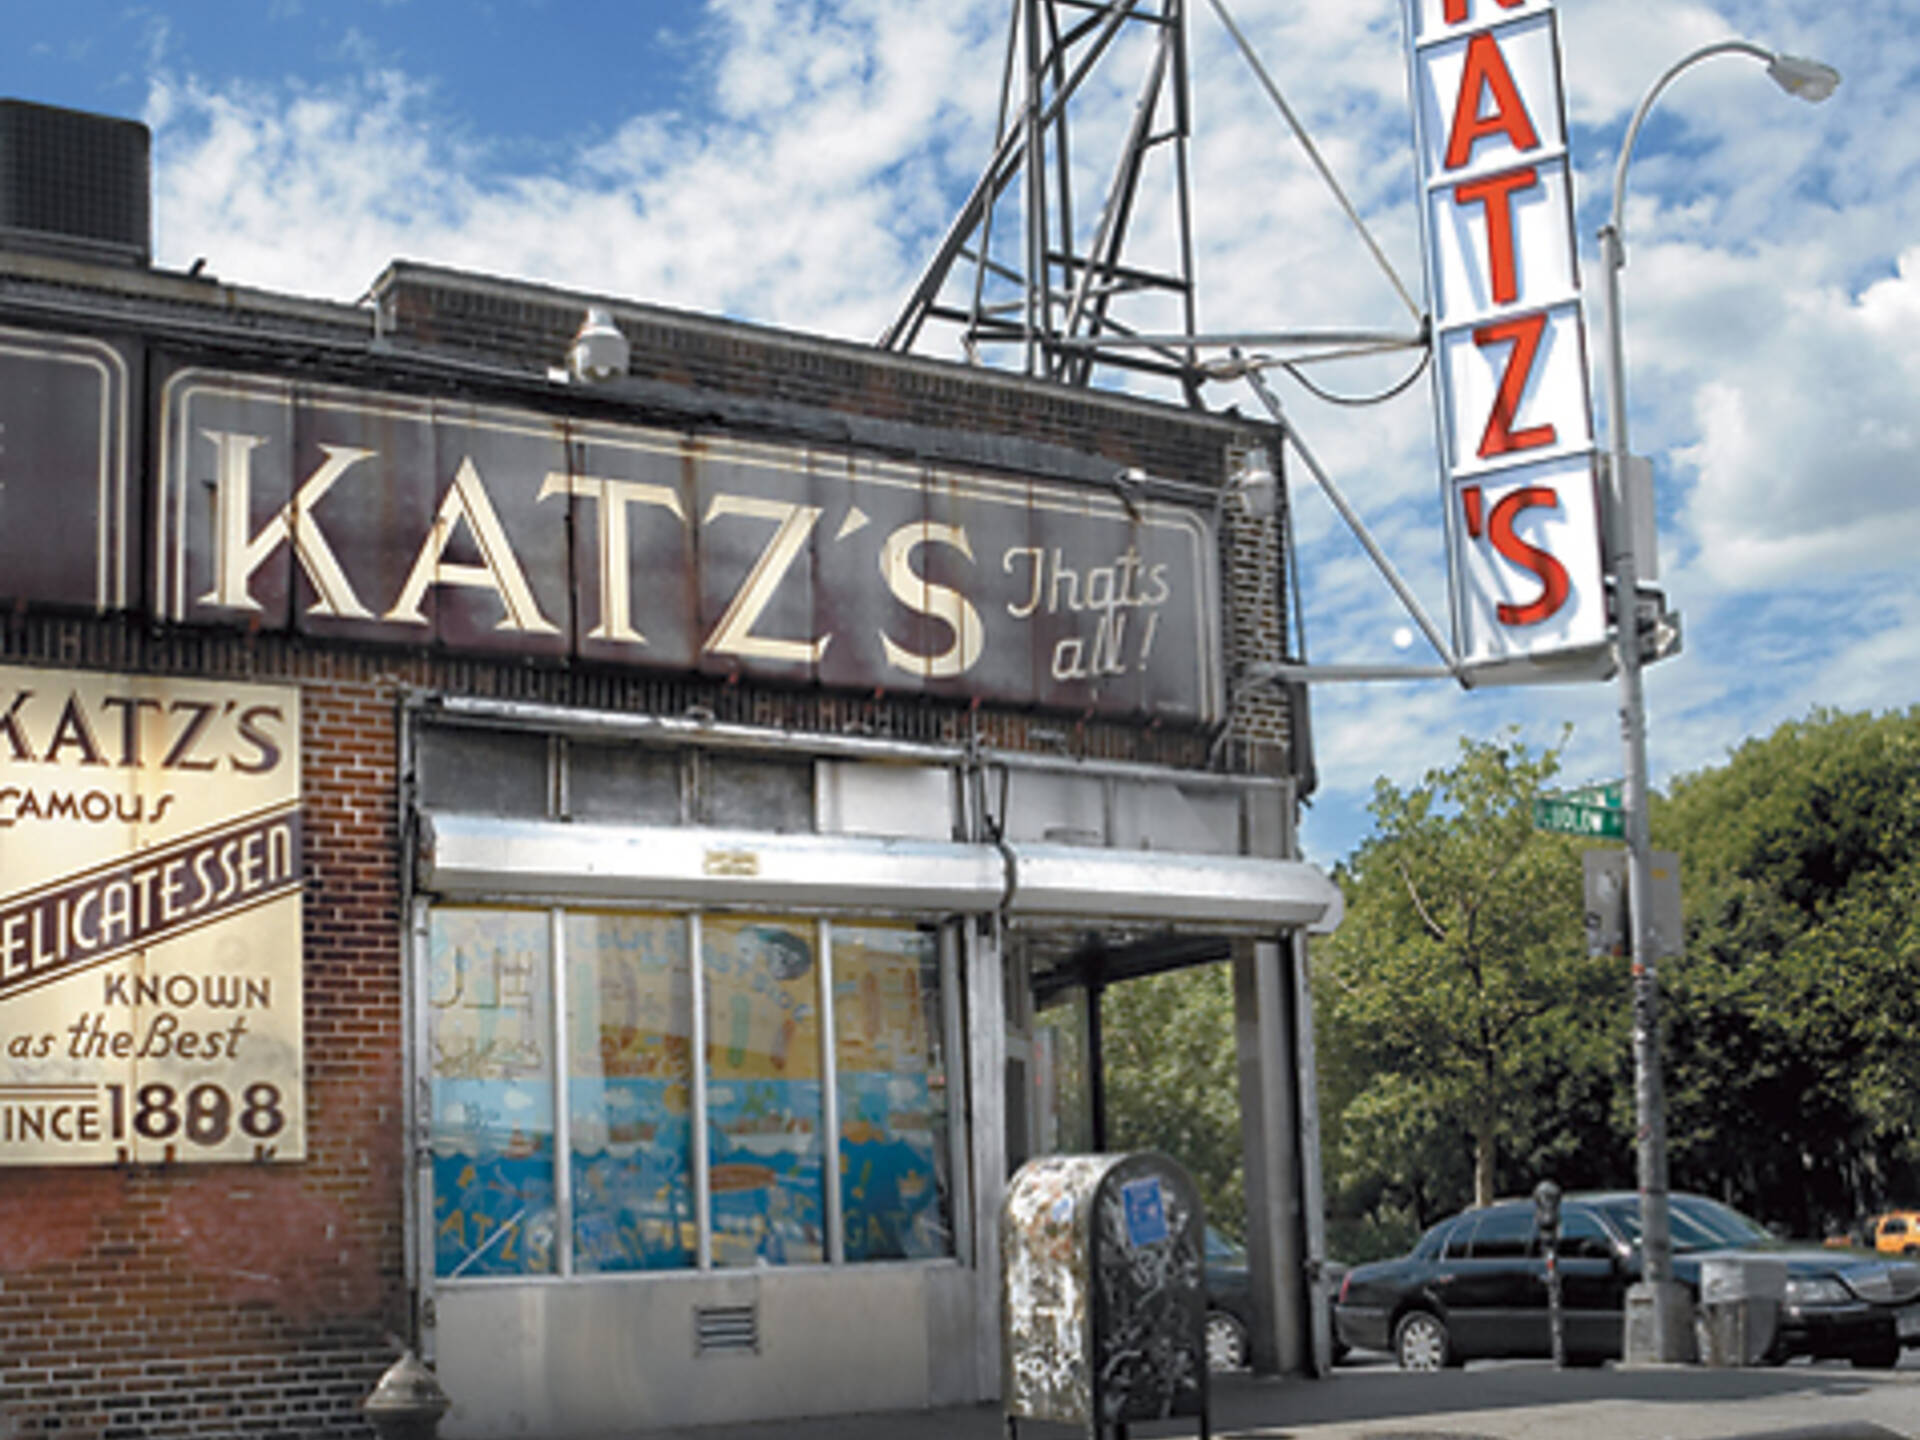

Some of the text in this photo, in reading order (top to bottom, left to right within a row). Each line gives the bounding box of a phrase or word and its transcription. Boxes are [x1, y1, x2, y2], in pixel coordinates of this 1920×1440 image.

[1443, 0, 1571, 626] ATZ'S
[198, 429, 986, 678] KATZ'S
[1003, 545, 1170, 618] That's
[0, 823, 293, 979] ELICATESSEN
[104, 973, 272, 1008] KNOWN
[8, 1011, 248, 1059] as the Best
[0, 1104, 100, 1142] INCE
